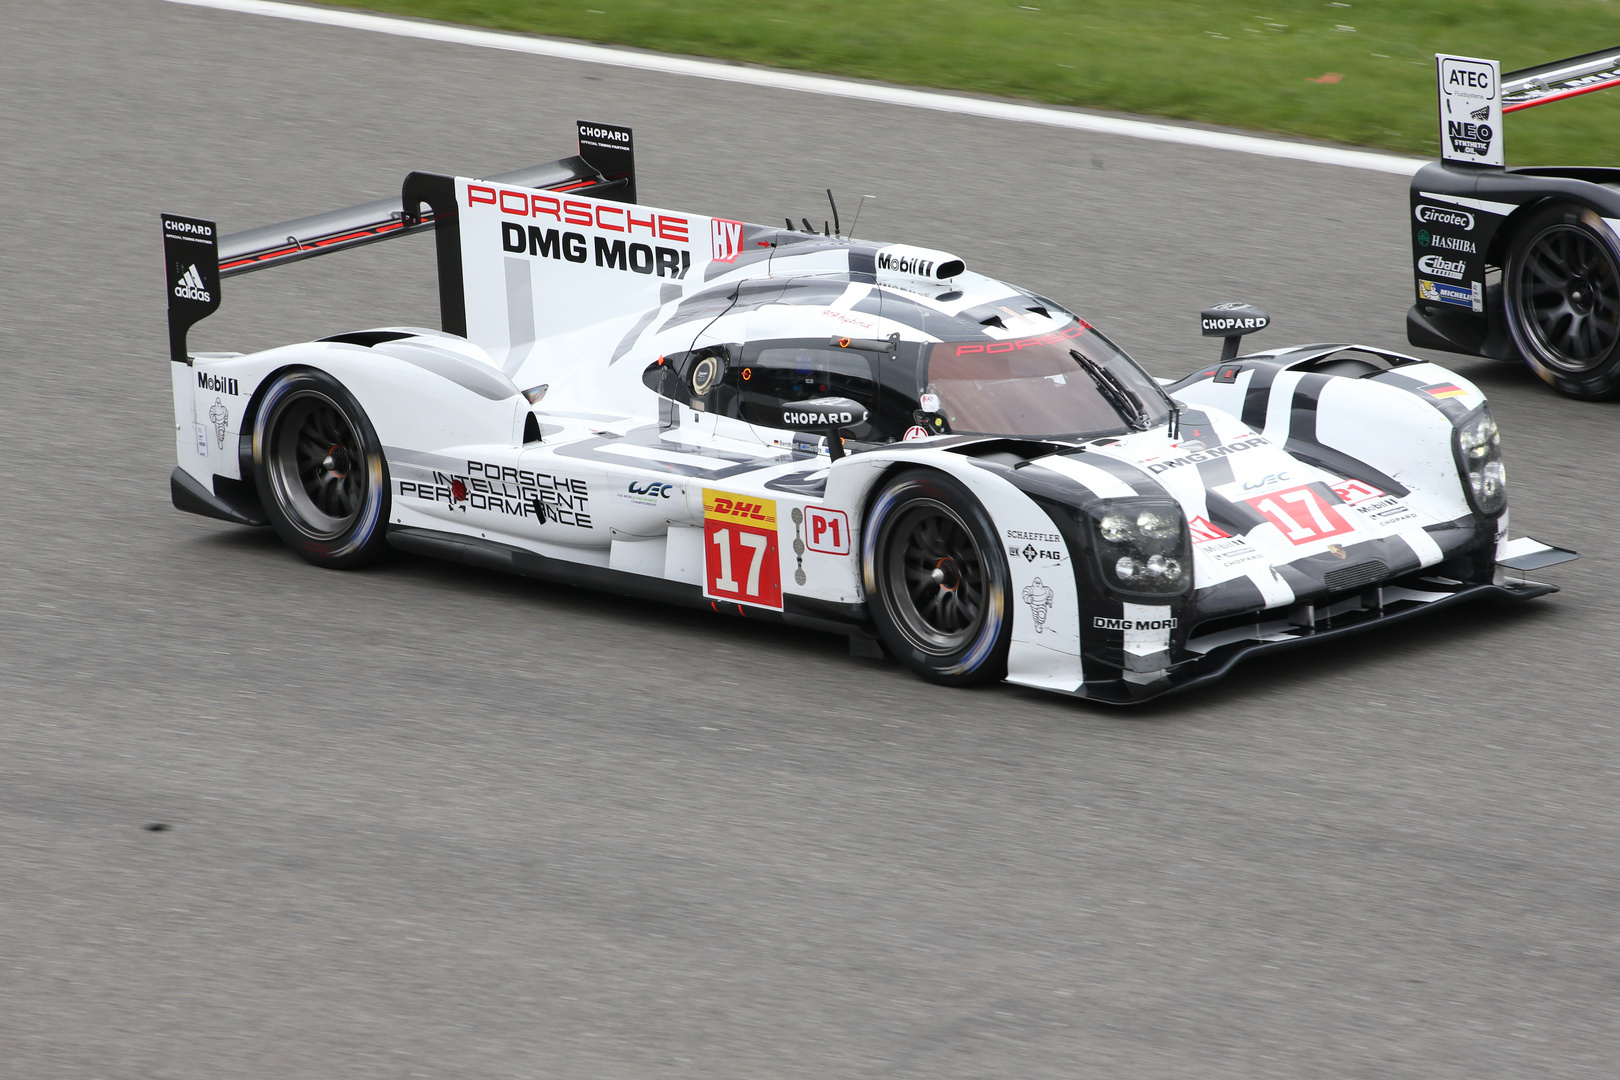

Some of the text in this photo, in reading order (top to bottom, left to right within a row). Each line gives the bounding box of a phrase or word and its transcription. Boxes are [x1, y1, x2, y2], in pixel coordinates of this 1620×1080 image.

[1449, 69, 1488, 89] ATEC
[579, 126, 630, 142] CHOPARD
[1448, 120, 1493, 142] NEO
[1454, 139, 1487, 150] SYNTHETIC
[467, 184, 689, 243] PORSCHE
[1423, 209, 1467, 227] zircotec
[164, 220, 212, 236] CHOPARD
[712, 219, 742, 260] HY
[1431, 234, 1476, 254] HASHIBA
[501, 221, 691, 280] DMG MORI
[878, 252, 916, 274] Mobil
[1418, 254, 1466, 280] Eibach
[174, 286, 211, 302] adidas
[1202, 317, 1267, 330] CHOPARD
[197, 371, 227, 394] Mobil
[783, 411, 853, 425] CHOPARD
[1147, 453, 1208, 475] DMG
[467, 460, 589, 496] PORSCHE
[1242, 471, 1291, 491] WEC
[432, 470, 589, 512] INTELLIGENT
[628, 480, 673, 499] WEC
[713, 497, 766, 521] DHL
[1256, 488, 1336, 541] 17
[1357, 500, 1388, 513] Mobil
[1379, 513, 1418, 527] CHOPARD
[812, 514, 841, 547] P1
[1006, 529, 1061, 543] SCHAEFFLER
[1040, 549, 1060, 560] FAG
[1203, 541, 1235, 554] Mobil
[712, 528, 768, 597] 17
[1223, 553, 1264, 568] CHOPARD
[1094, 618, 1178, 631] DMG MORI
